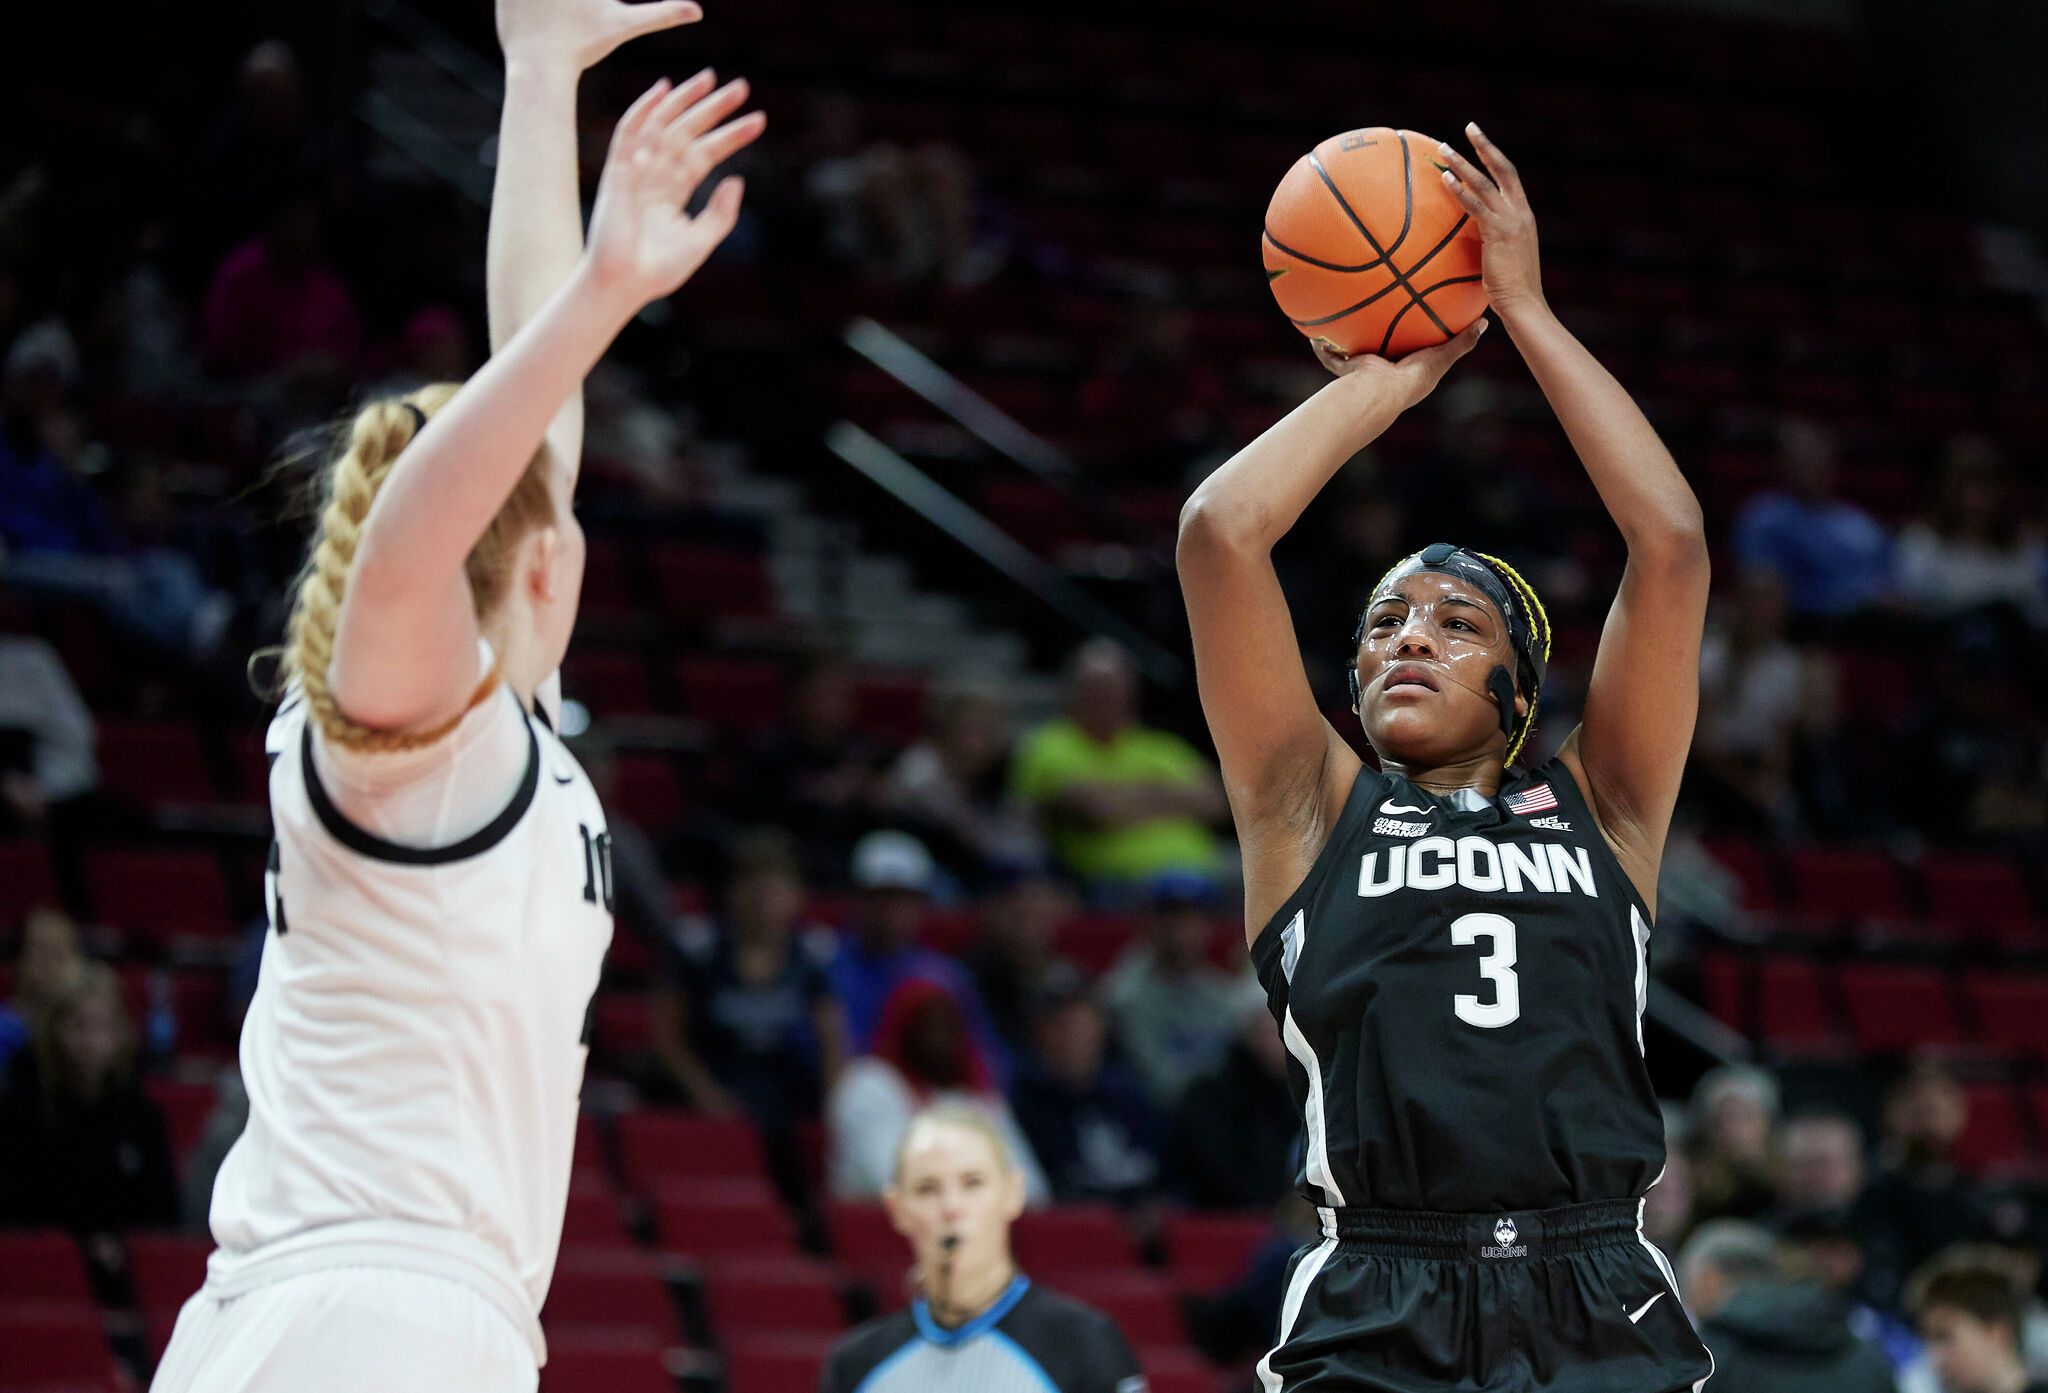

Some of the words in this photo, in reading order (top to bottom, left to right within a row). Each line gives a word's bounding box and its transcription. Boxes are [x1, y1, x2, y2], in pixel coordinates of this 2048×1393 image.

[1529, 815, 1559, 825] BIG
[1372, 826, 1428, 838] CHANGE
[1358, 836, 1599, 898] UCONN
[1450, 912, 1521, 1029] 3
[1481, 1244, 1528, 1259] UCONN
